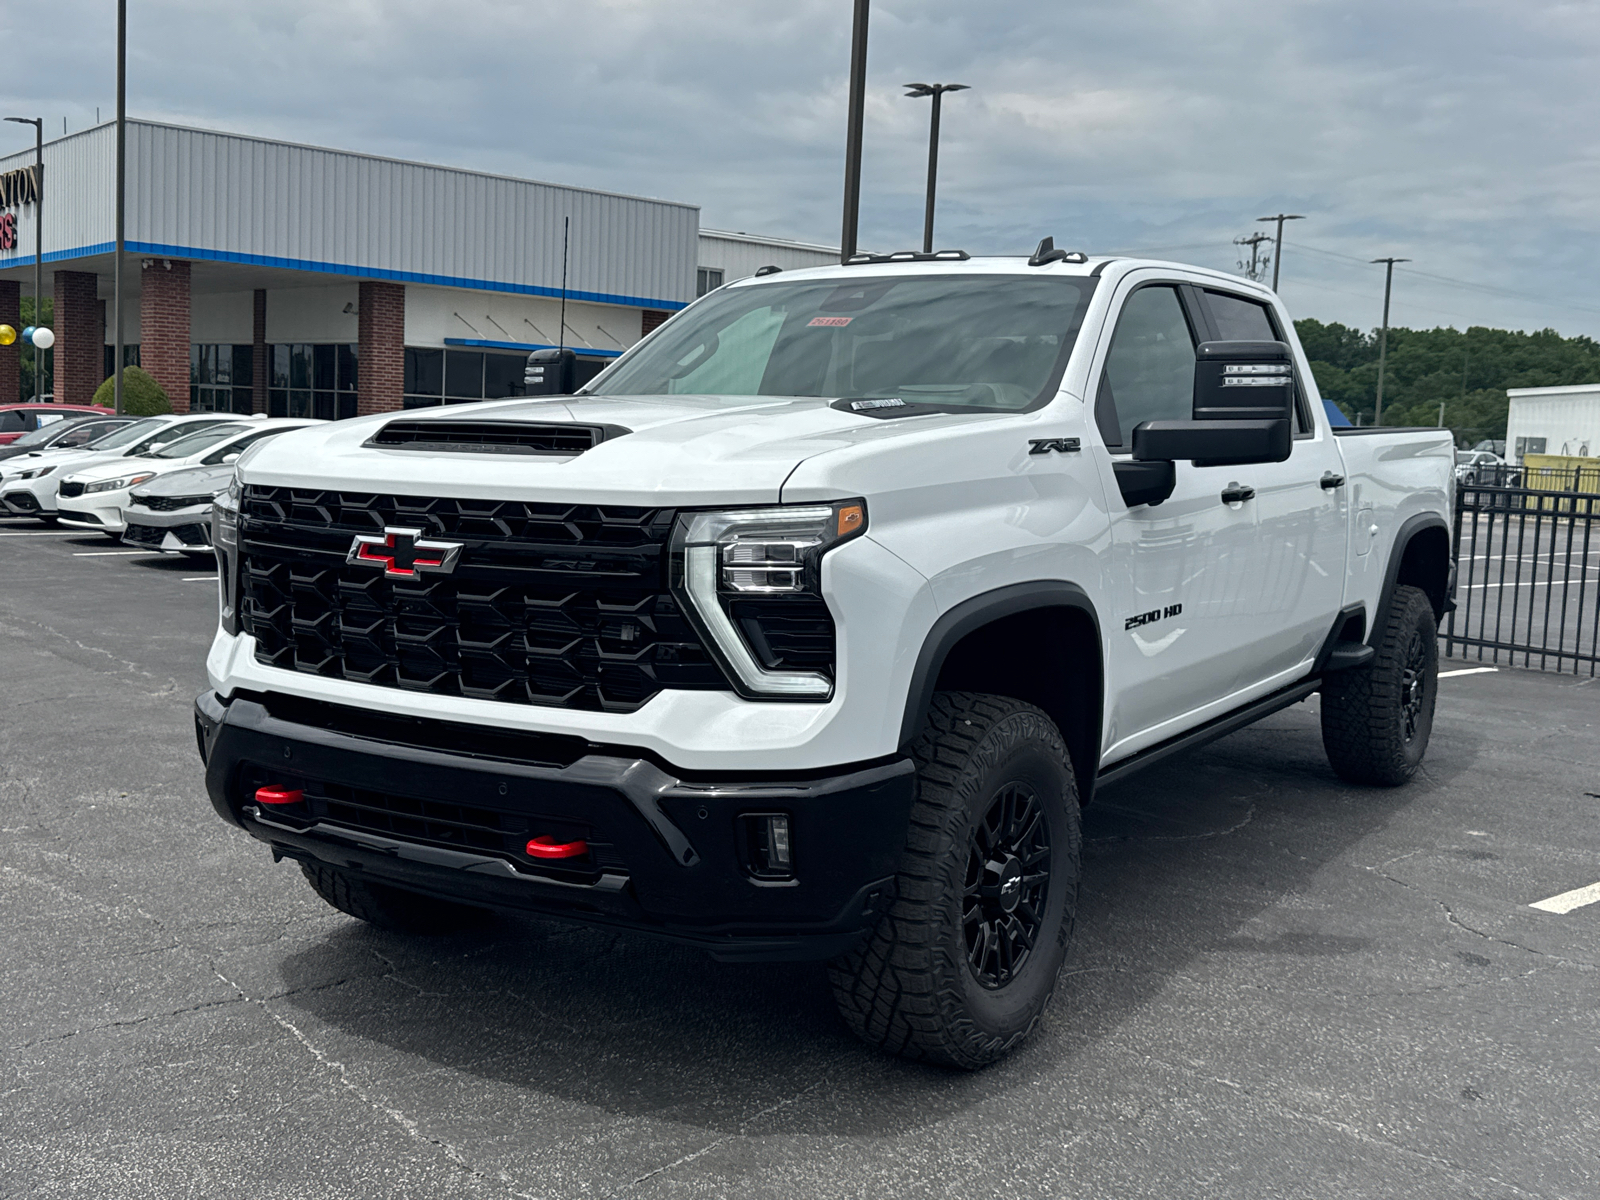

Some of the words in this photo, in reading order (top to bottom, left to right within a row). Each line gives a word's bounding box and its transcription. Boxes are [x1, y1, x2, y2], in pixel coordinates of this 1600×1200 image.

[1028, 437, 1081, 455] ZR2
[1125, 609, 1161, 631] 2500
[1163, 603, 1182, 619] HD
